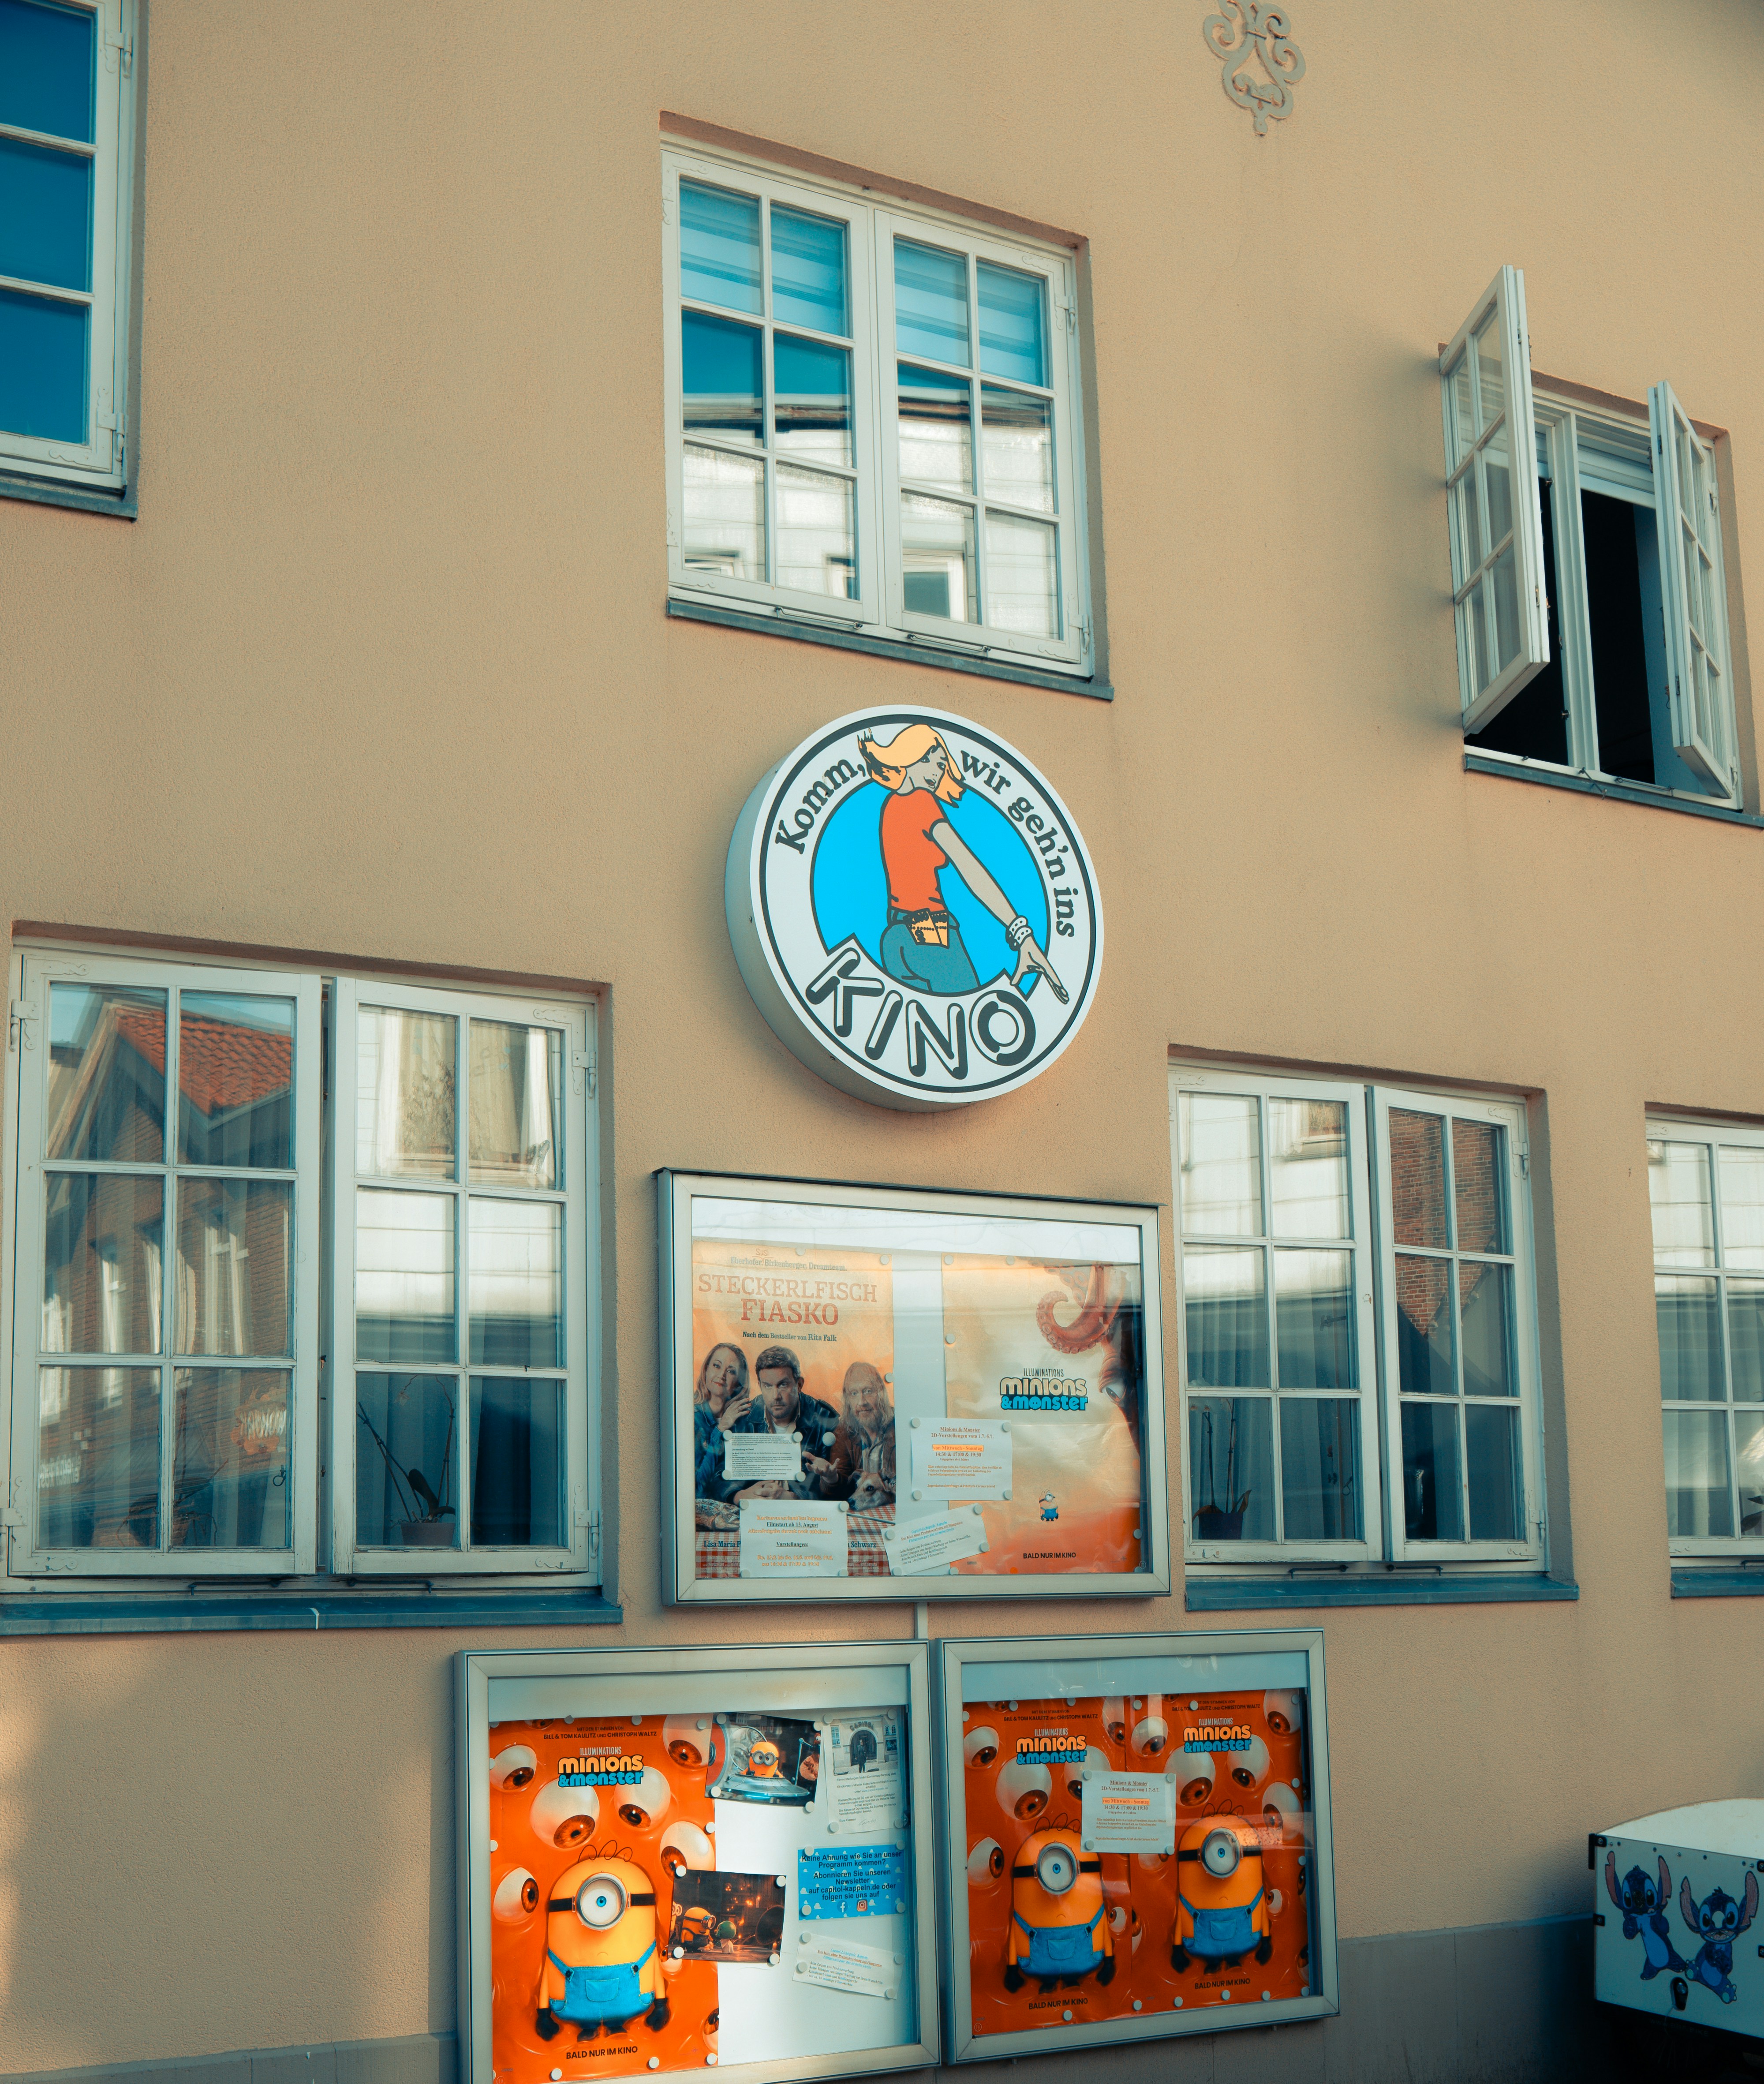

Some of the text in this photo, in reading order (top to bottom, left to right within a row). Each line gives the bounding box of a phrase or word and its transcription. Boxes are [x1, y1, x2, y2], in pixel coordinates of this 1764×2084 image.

[775, 756, 867, 854] Komm,
[960, 750, 1011, 795] wir
[1054, 887, 1079, 938] ins
[805, 947, 1036, 1080] KINO
[731, 1257, 847, 1271] Eberhofer. Birkenberger. Dreamteam.
[698, 1273, 877, 1302] STECKERLFISCH
[741, 1298, 838, 1325] FIASKO
[1024, 1368, 1064, 1377] ILLUMINATIONS
[1035, 1728, 1068, 1736] ILLUMINATIONS
[580, 1746, 622, 1756] ILLUMINATIONS
[821, 1884, 880, 1894] capitol-kappeln.de
[822, 1893, 842, 1901] folgen
[566, 2051, 587, 2059] BALD
[589, 2049, 605, 2058] NUR
[618, 2046, 638, 2054] KINO
